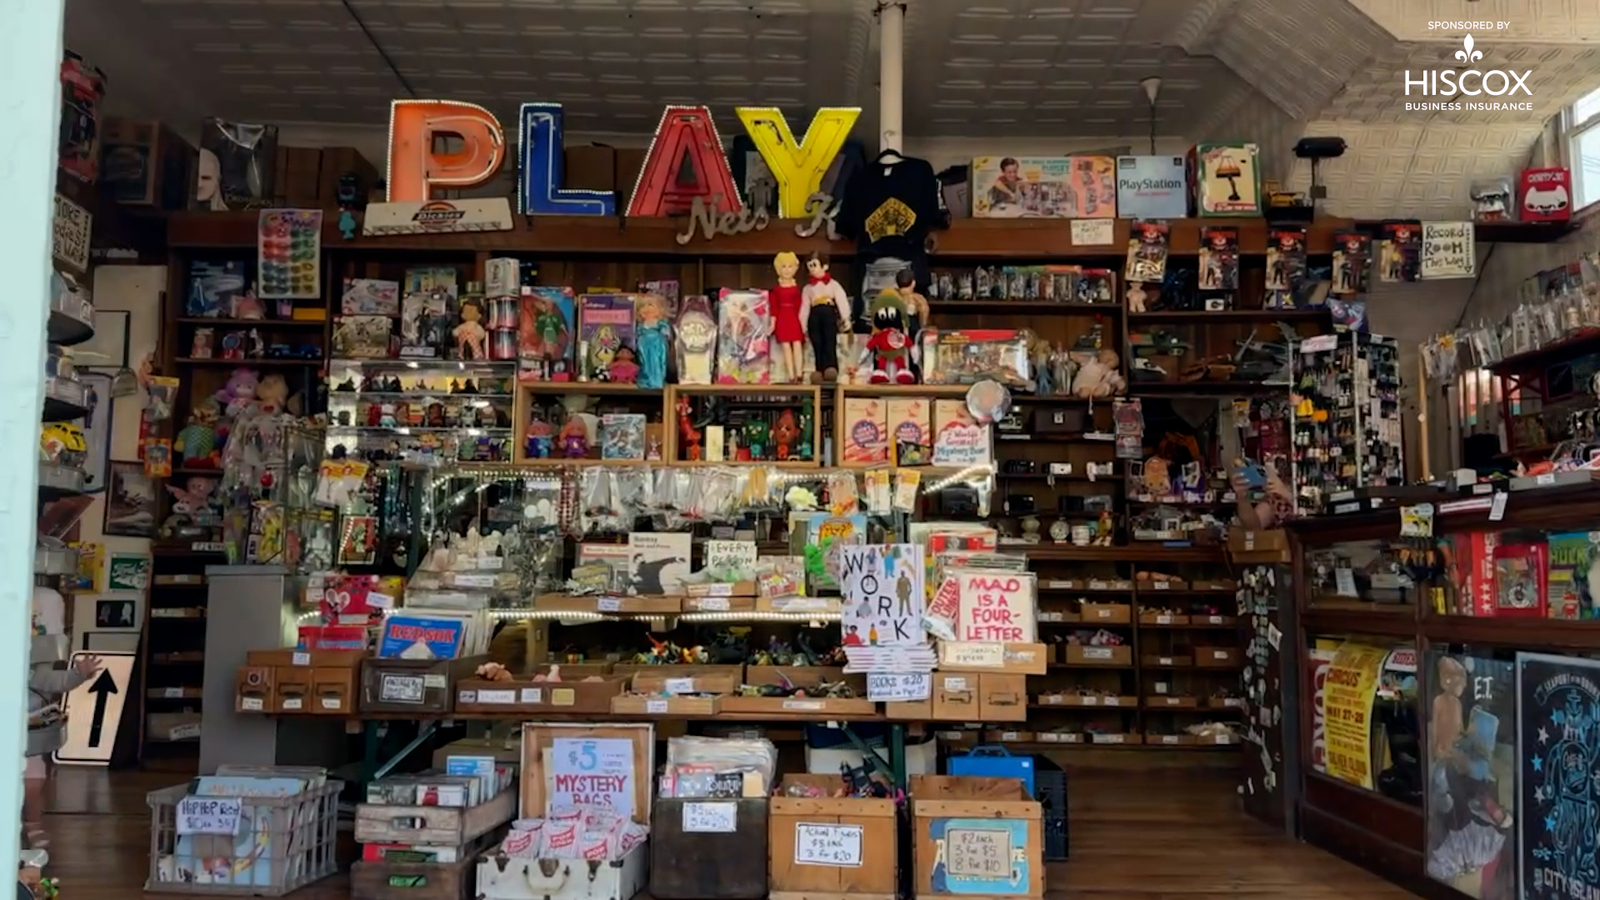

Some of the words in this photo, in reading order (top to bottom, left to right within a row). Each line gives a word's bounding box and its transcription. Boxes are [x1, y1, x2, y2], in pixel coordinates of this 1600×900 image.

[386, 99, 862, 218] PLAY
[1119, 179, 1182, 192] PlayStation
[418, 210, 461, 221] Dickies
[716, 542, 750, 553] EVERY
[968, 577, 1021, 592] MAD
[930, 579, 957, 614] OUTER
[977, 593, 993, 607] IS
[997, 593, 1009, 607] A
[388, 623, 423, 641] RED
[966, 625, 1023, 641] LETTER
[1474, 675, 1494, 700] E.T.
[568, 744, 598, 771] $5
[555, 774, 628, 793] MYSTERY
[961, 832, 976, 843] $2
[955, 845, 963, 856] 3
[981, 845, 997, 857] $5
[954, 857, 963, 871] 8
[984, 858, 1001, 872] $10
[1544, 867, 1568, 893] CITY
